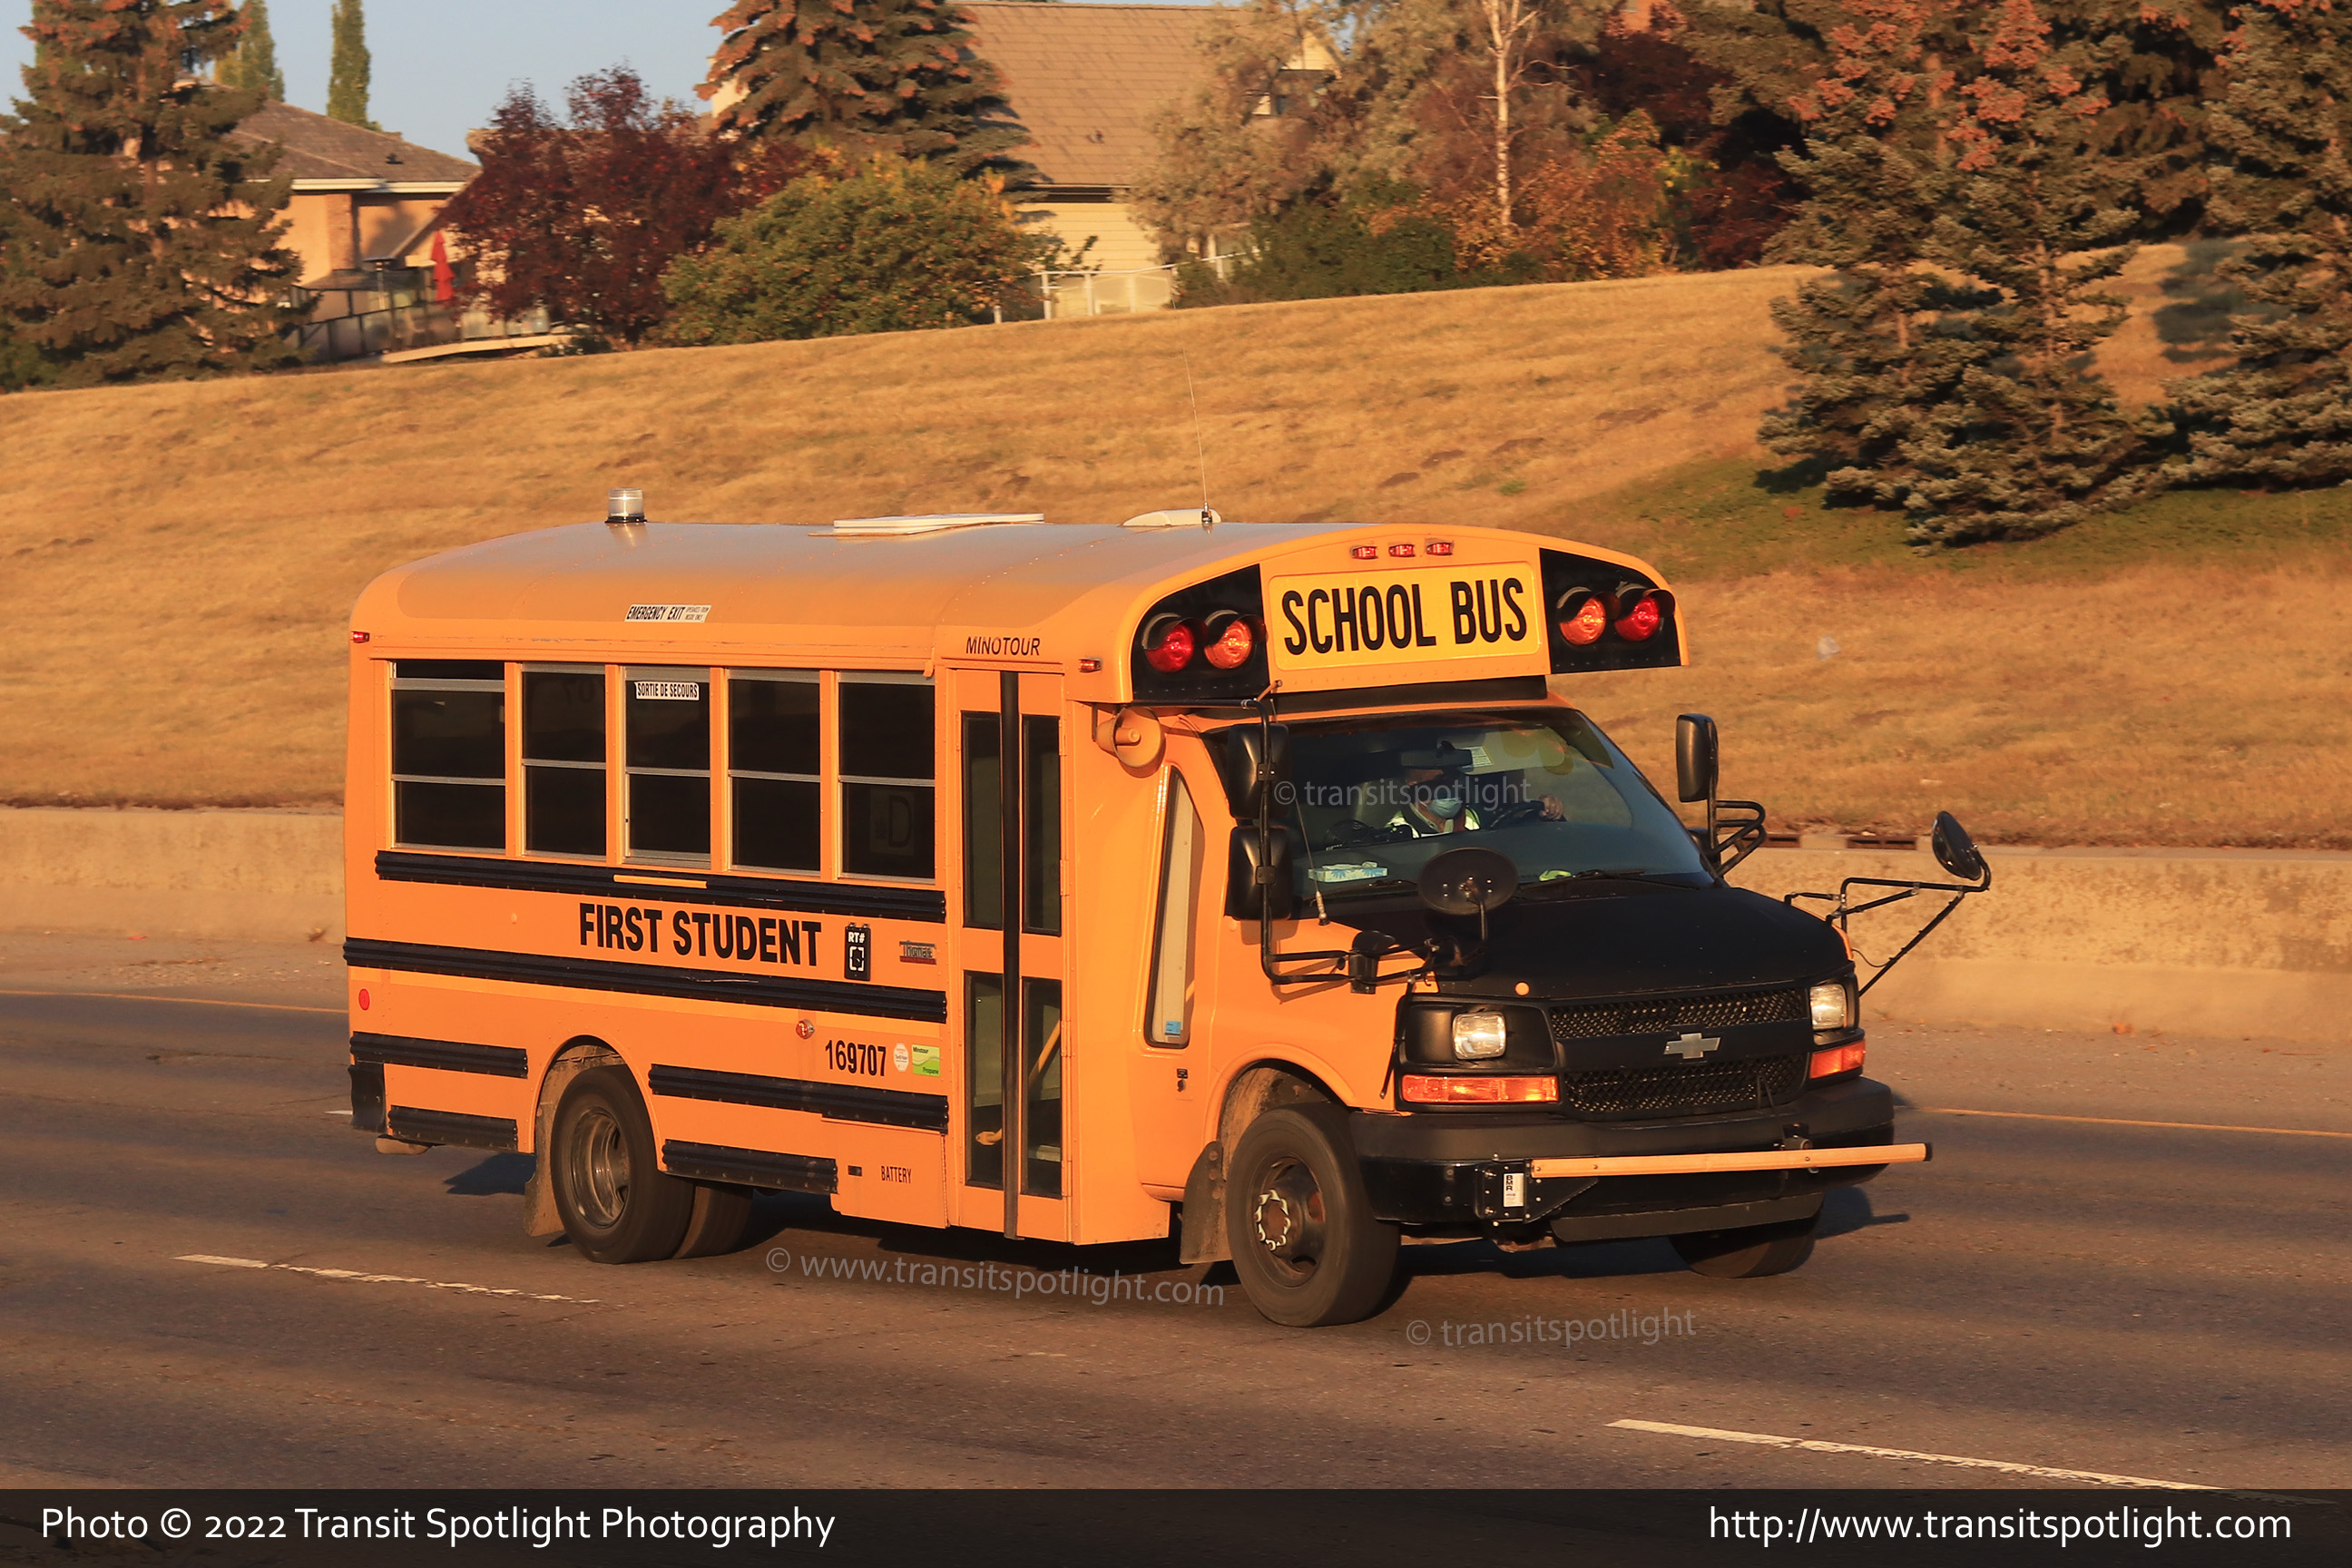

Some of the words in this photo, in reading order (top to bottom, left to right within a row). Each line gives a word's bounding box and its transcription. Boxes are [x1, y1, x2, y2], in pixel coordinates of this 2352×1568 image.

[626, 605, 668, 620] EMERGENCY
[667, 606, 686, 620] EXIT
[1281, 583, 1437, 655] SCHOOL
[1450, 577, 1527, 644] BUS
[965, 636, 1041, 656] MINOTOUR
[637, 682, 659, 697] SORTIE
[660, 683, 668, 697] DE
[670, 683, 698, 698] SECOURS
[579, 902, 662, 953] FIRST
[672, 910, 822, 966] STUDENT
[848, 931, 866, 944] RT#
[825, 1039, 887, 1077] 169707
[880, 1165, 912, 1184] BATTERY
